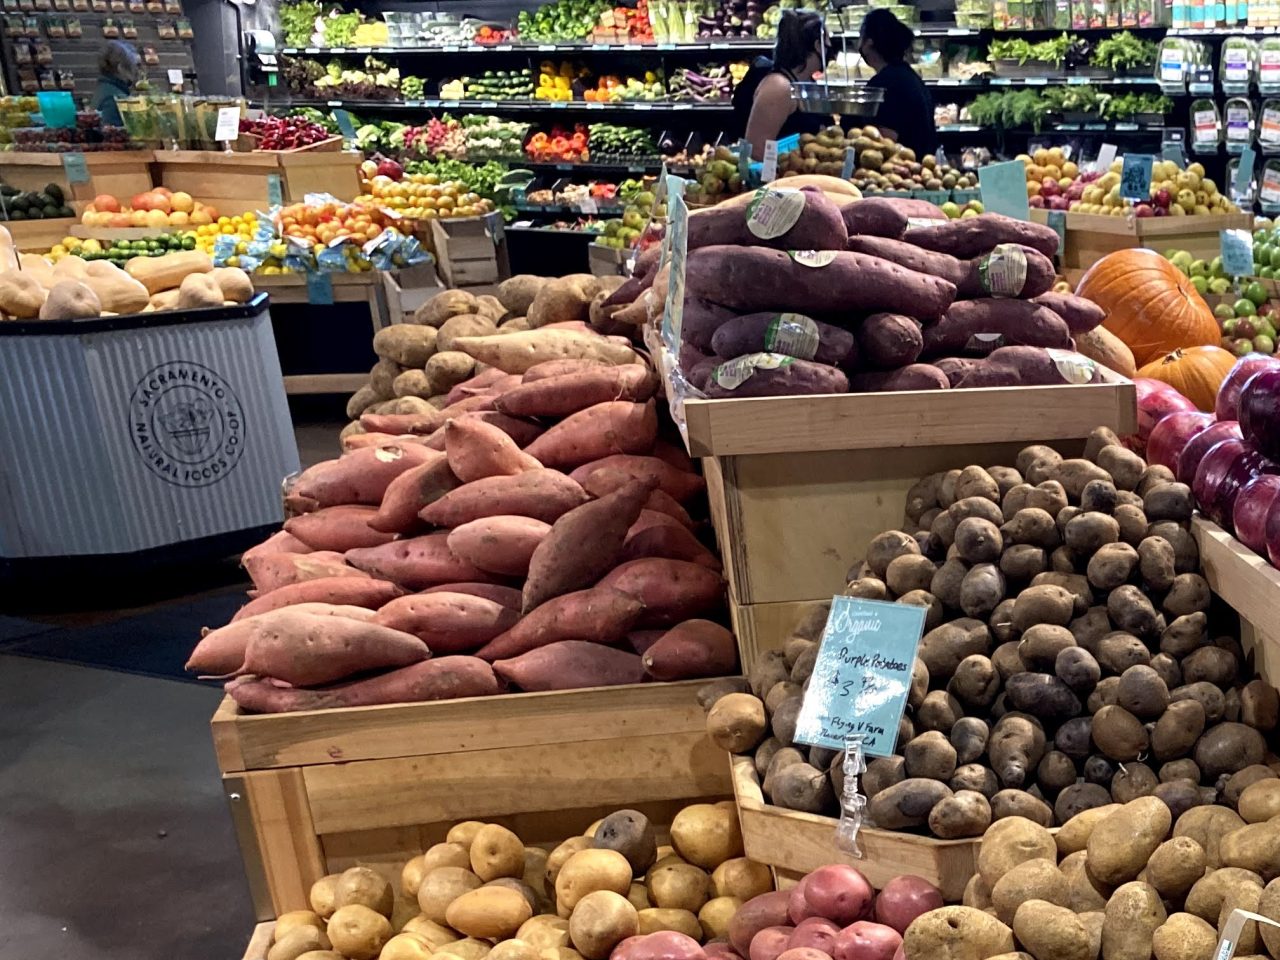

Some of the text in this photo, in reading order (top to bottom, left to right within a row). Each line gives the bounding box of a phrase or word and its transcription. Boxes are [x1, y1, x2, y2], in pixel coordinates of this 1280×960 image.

[140, 369, 225, 408] SACRAMENTO
[136, 411, 239, 481] NATURAL FOODS CO-OP
[834, 603, 882, 643] Organic
[839, 647, 868, 669] Purple
[831, 717, 884, 735] Flying V Farm
